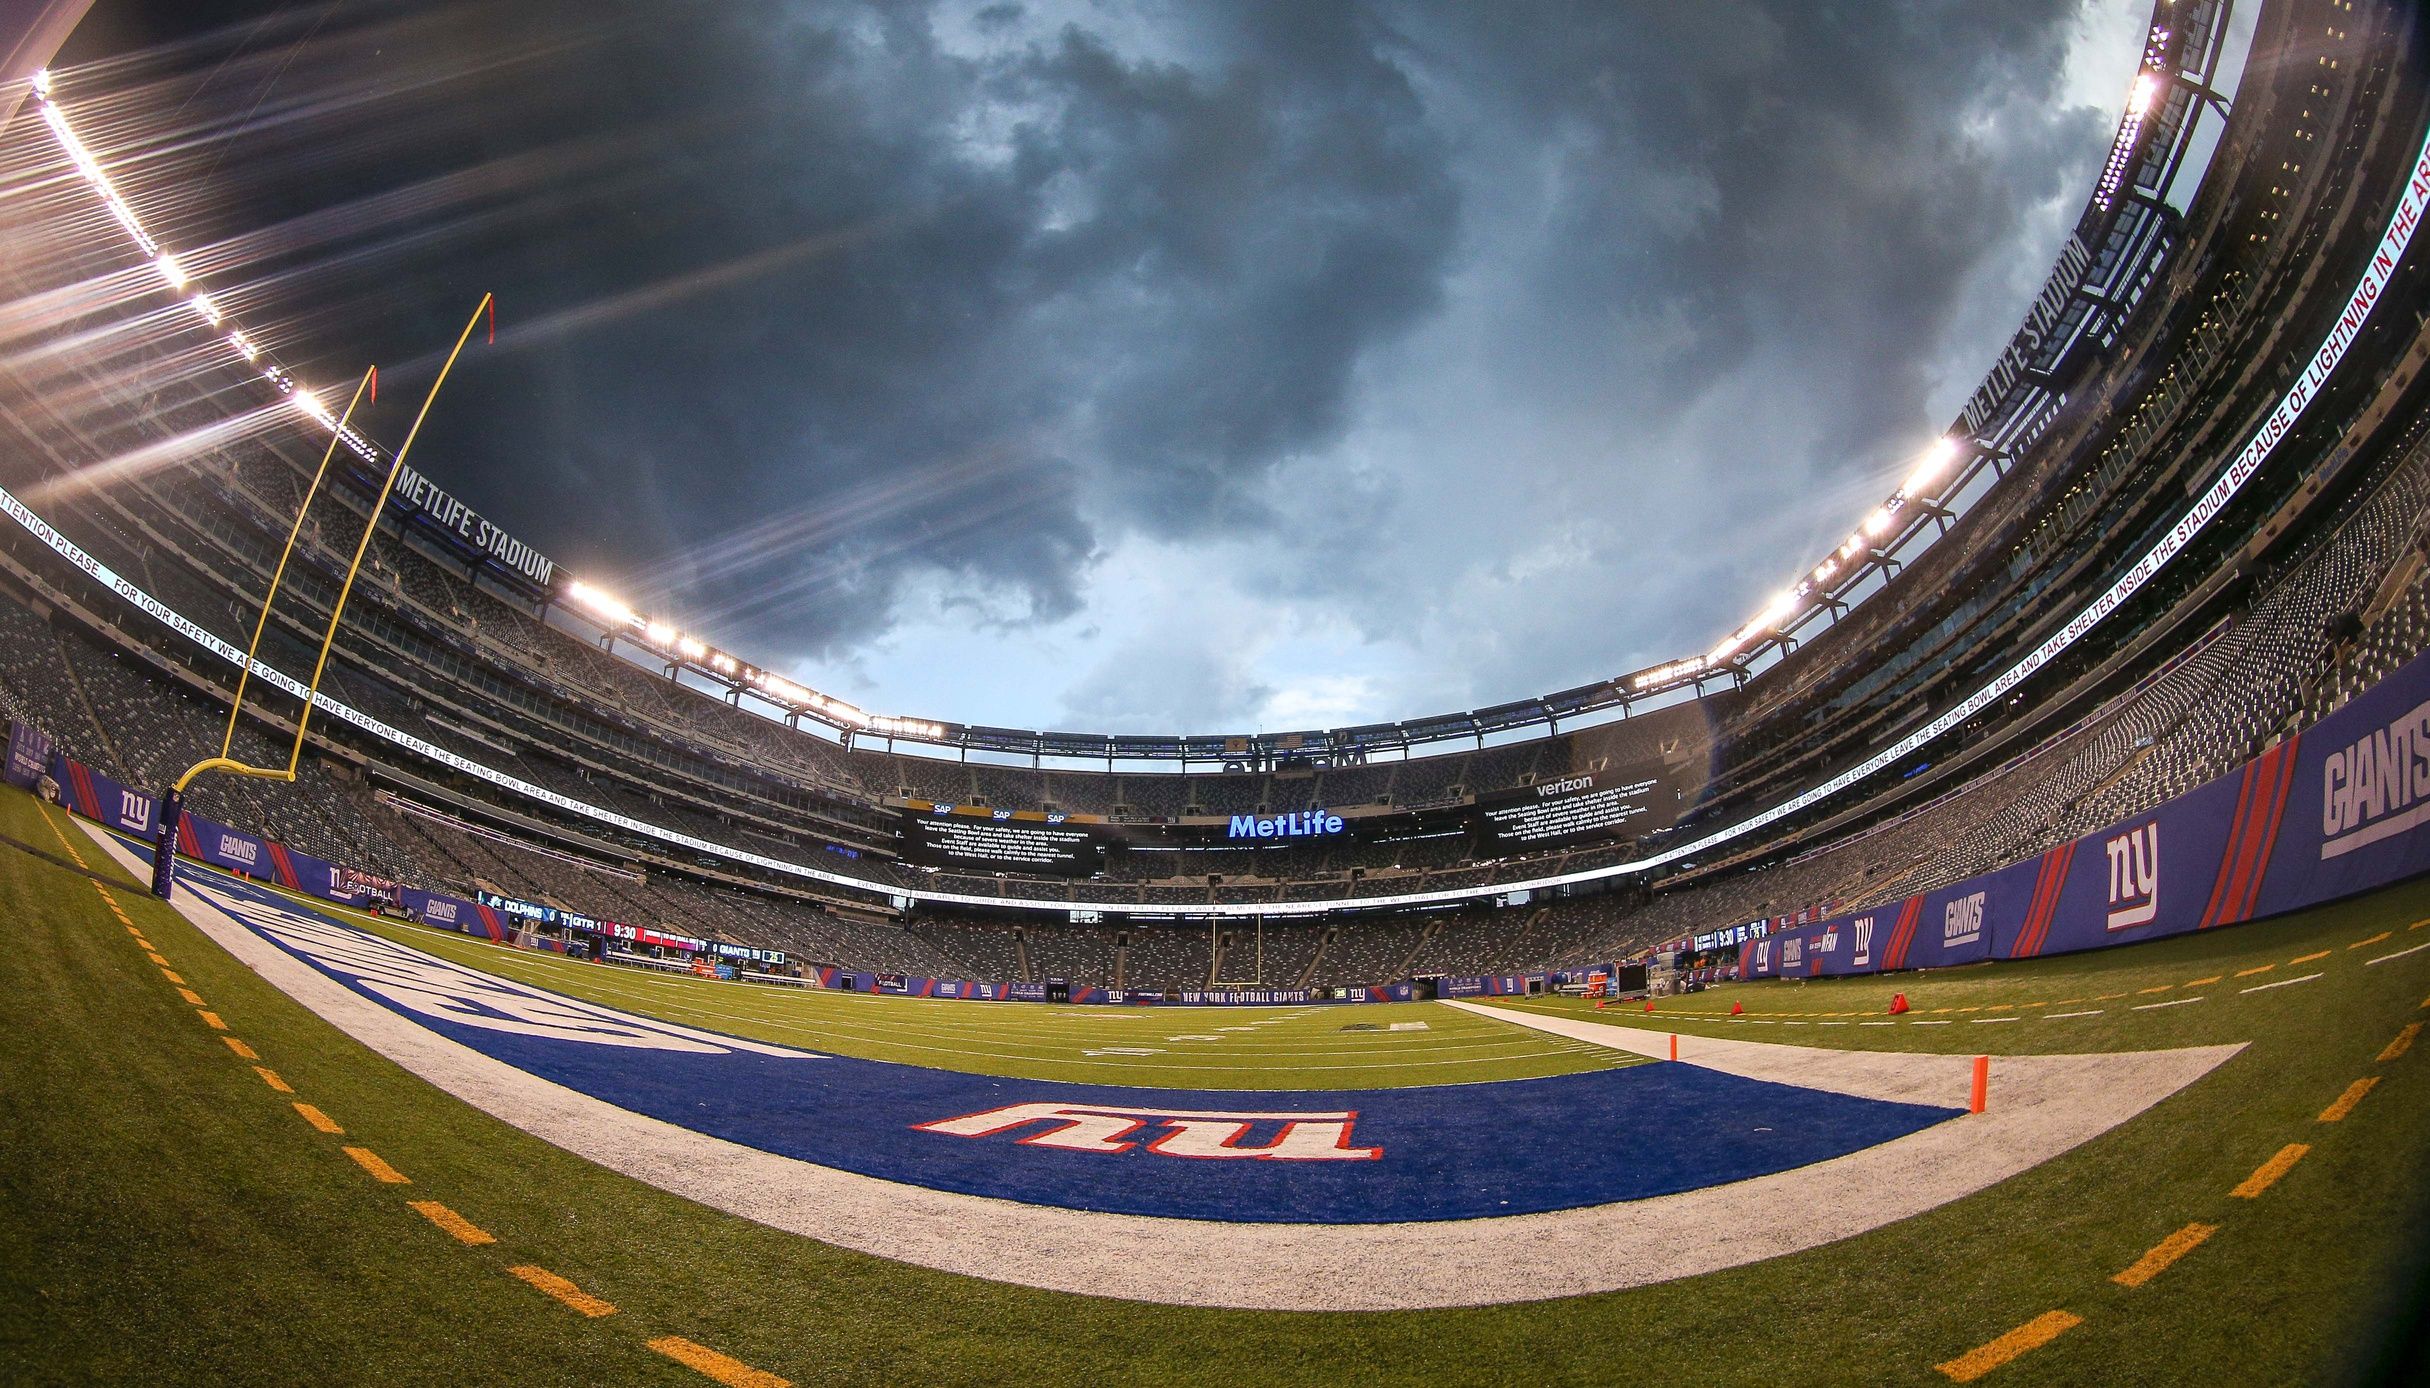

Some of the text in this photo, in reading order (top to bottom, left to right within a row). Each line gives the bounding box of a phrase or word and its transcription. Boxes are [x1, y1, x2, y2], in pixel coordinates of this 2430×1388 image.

[1962, 228, 2092, 435] METLIFE STADIUM
[395, 466, 553, 586] METLIFE STADIUM
[1724, 827, 1736, 836] FOR
[1737, 820, 1753, 832] YOUR
[1753, 810, 1775, 826] SAFETY
[1776, 804, 1786, 815] WE
[1787, 798, 1800, 810] ARE
[1801, 788, 1822, 804] GOING
[1822, 783, 1832, 794] TO
[1832, 772, 1851, 789] HAVE
[1851, 752, 1889, 780] EVERYONE
[1889, 737, 1914, 759] LEAVE
[1914, 727, 1931, 744] THE
[1932, 704, 1966, 734] SEATING
[1966, 688, 1993, 712] BOWL
[1994, 668, 2020, 695] AREA
[2020, 652, 2040, 677] AND
[2040, 631, 2067, 660] TAKE
[2067, 592, 2115, 639] SHELTER
[2114, 557, 2152, 600] INSIDE
[2150, 534, 2176, 565] THE
[2176, 477, 2230, 542] STADIUM
[2228, 405, 2290, 487] BECAUSE
[2288, 378, 2307, 413] OF
[2306, 275, 2377, 388] LIGHTNING
[2372, 246, 2393, 282] IN
[2385, 196, 2418, 251] THE
[113, 577, 138, 602] FOR
[140, 593, 171, 623] YOUR
[172, 615, 216, 648] SAFETY
[217, 641, 235, 660] WE
[260, 666, 305, 696] GOING
[314, 693, 342, 715] HAVE
[343, 708, 397, 740] EVERYONE
[399, 733, 430, 754] LEAVE
[433, 747, 451, 763] THE
[453, 756, 492, 779] SEATING
[494, 772, 520, 790] BOWL
[522, 784, 546, 799] AREA
[548, 793, 566, 806] AND
[569, 800, 590, 814] TAKE
[592, 808, 628, 826] SHELTER
[630, 821, 656, 835] INSIDE
[658, 829, 672, 840] THE
[675, 834, 707, 848] STADIUM
[708, 844, 742, 859] BECAUSE
[756, 858, 793, 871] LIGHTNING
[803, 868, 815, 876] THE
[817, 872, 834, 880] AREA
[1537, 776, 1593, 796] verizon
[121, 790, 150, 831] ny
[934, 805, 950, 813] SAP
[994, 811, 1010, 819] SAP
[1230, 810, 1342, 837] MetLife
[220, 834, 257, 862] GIANTS
[1654, 835, 1717, 862] YOUR ATTENTION PLEASE
[2107, 822, 2158, 932] ny
[427, 900, 456, 920] GIANTS
[505, 900, 555, 922] DOLPHINS 0
[573, 917, 594, 930] QTR
[1944, 891, 1985, 940] GIANTS
[614, 924, 636, 939] 9:30
[1720, 929, 1734, 947] 9:30
[1853, 917, 1873, 966] ny
[713, 944, 749, 958] 0 GIANTS
[1184, 990, 1304, 1002] NEW YORK FOOTBALL GIANTS
